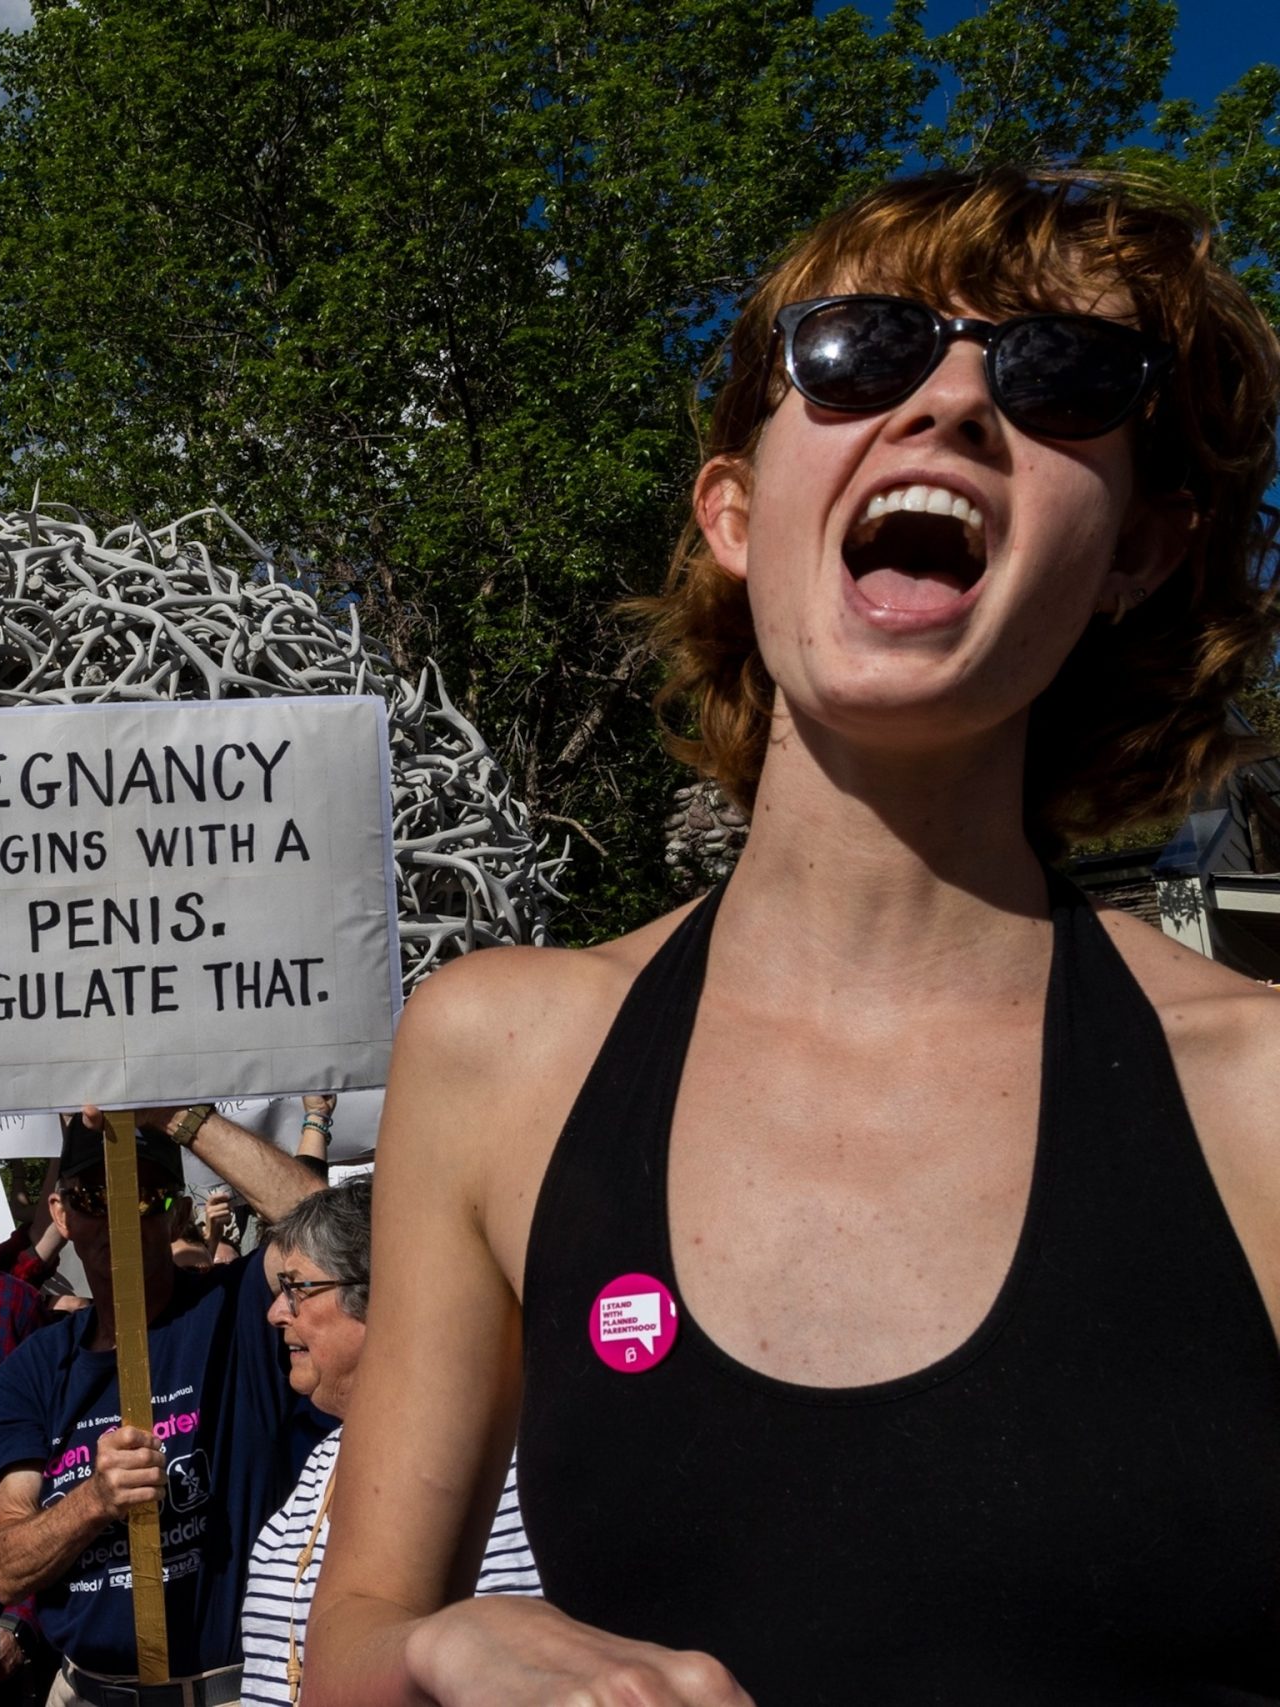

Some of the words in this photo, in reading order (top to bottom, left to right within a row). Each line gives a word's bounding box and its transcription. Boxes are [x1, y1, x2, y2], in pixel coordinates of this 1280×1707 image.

[136, 823, 255, 868] WITH
[275, 818, 310, 863] A
[28, 891, 226, 953] PENIS.
[203, 957, 330, 1013] THAT.
[607, 1301, 632, 1309] STAND
[603, 1310, 623, 1318] WITH
[603, 1317, 639, 1326] PLANNED
[603, 1324, 657, 1335] PARENTHOOD
